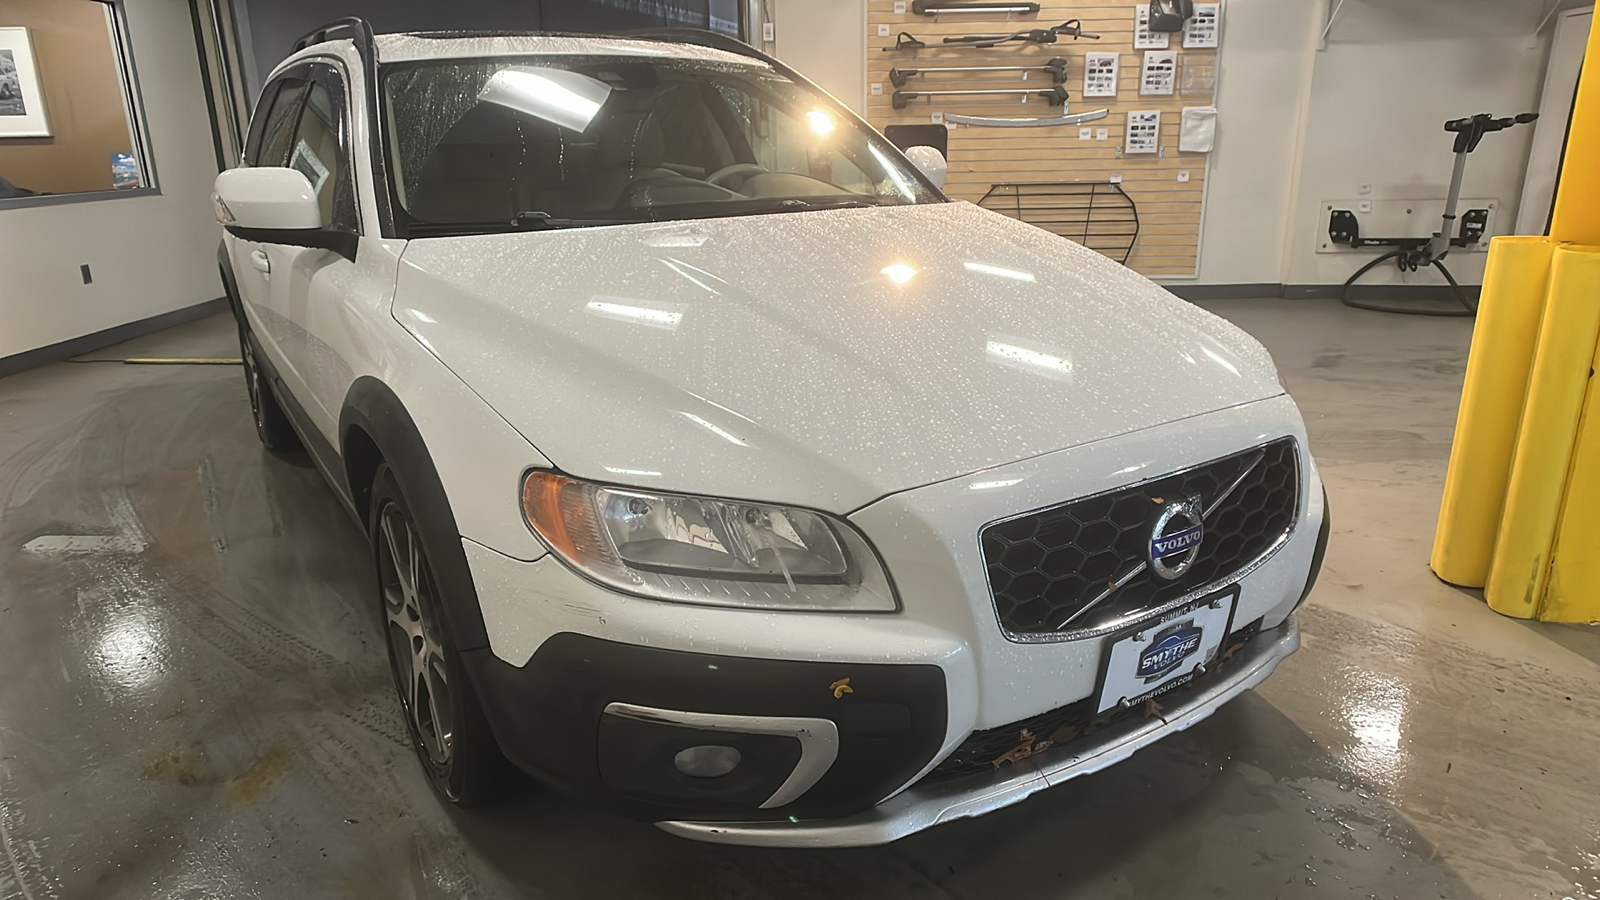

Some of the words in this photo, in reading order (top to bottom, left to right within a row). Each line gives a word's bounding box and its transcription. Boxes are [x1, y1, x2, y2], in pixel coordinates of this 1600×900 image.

[1155, 530, 1201, 553] VOLVO
[1141, 637, 1198, 669] SMYTHE
[1153, 651, 1185, 670] VOLVO
